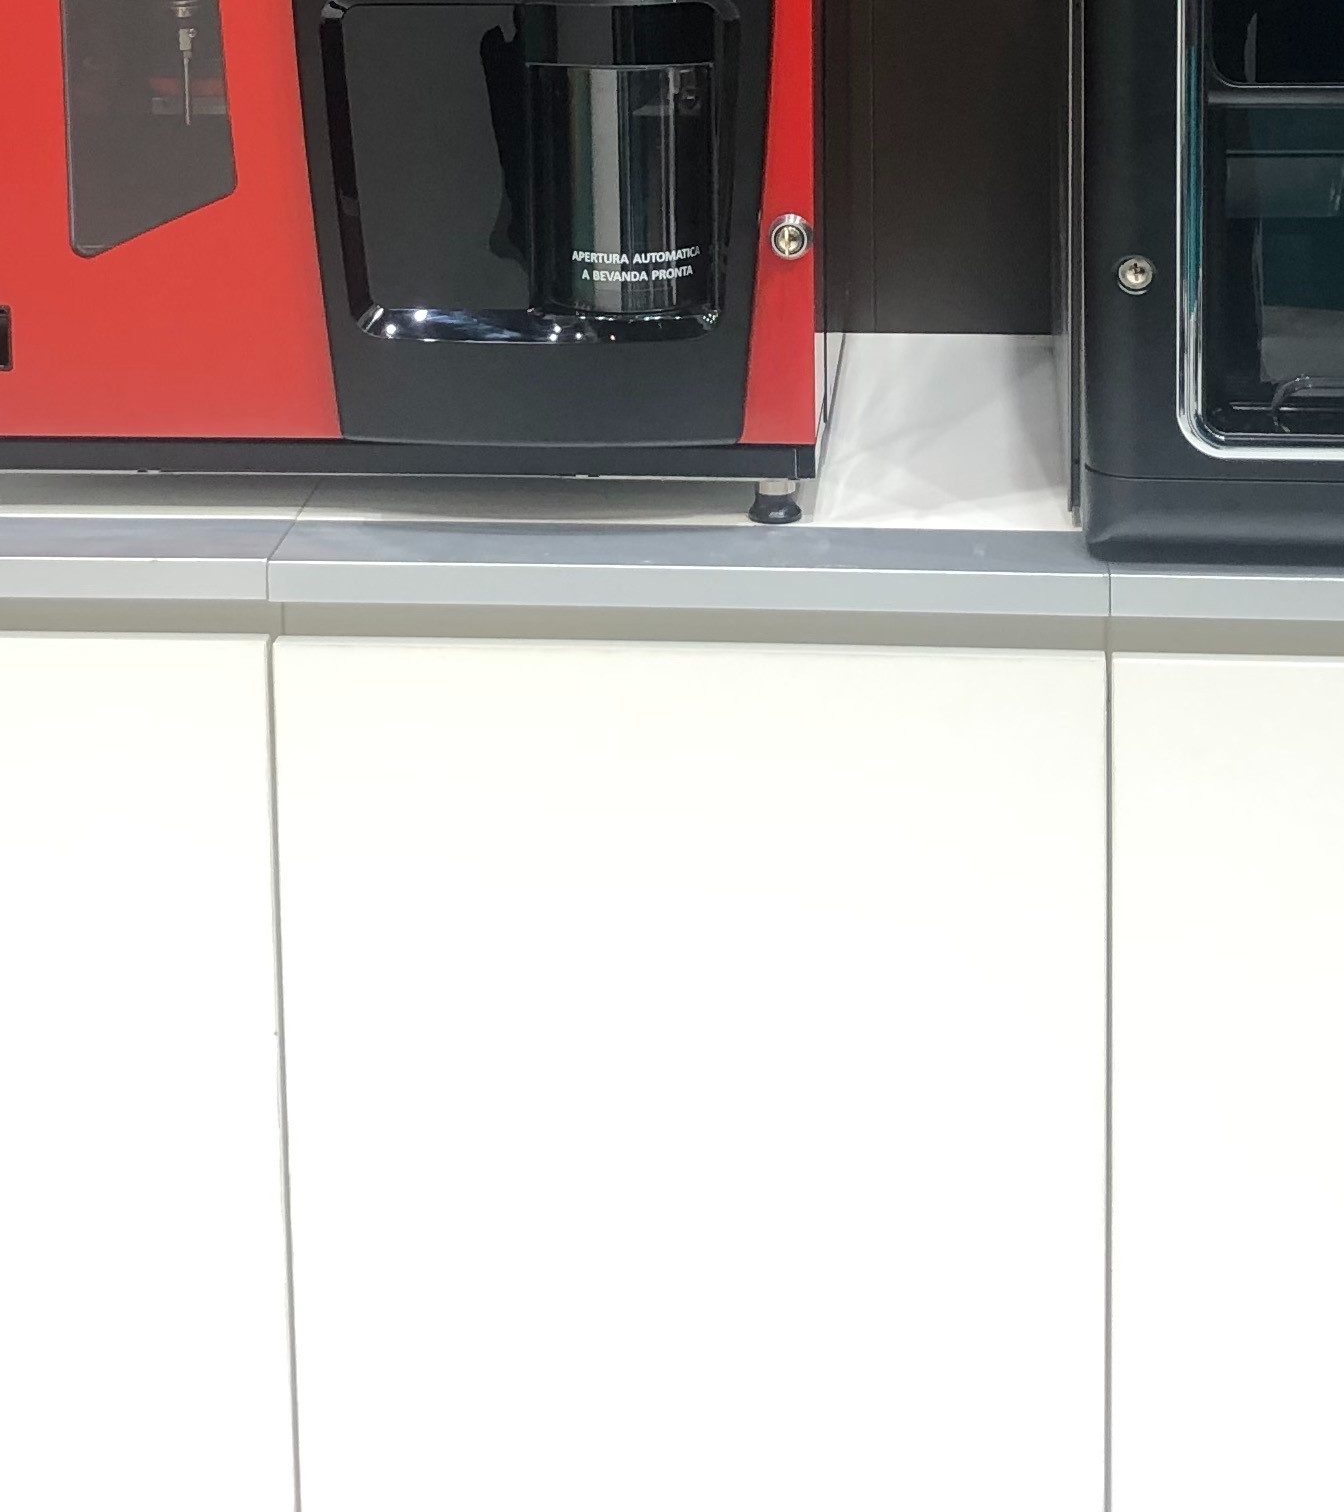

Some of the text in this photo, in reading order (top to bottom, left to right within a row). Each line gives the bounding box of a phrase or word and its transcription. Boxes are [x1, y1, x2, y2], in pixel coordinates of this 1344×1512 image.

[572, 246, 701, 264] APERTURA AUTOMATICA
[582, 265, 694, 282] A BEVANDA PRONTA
